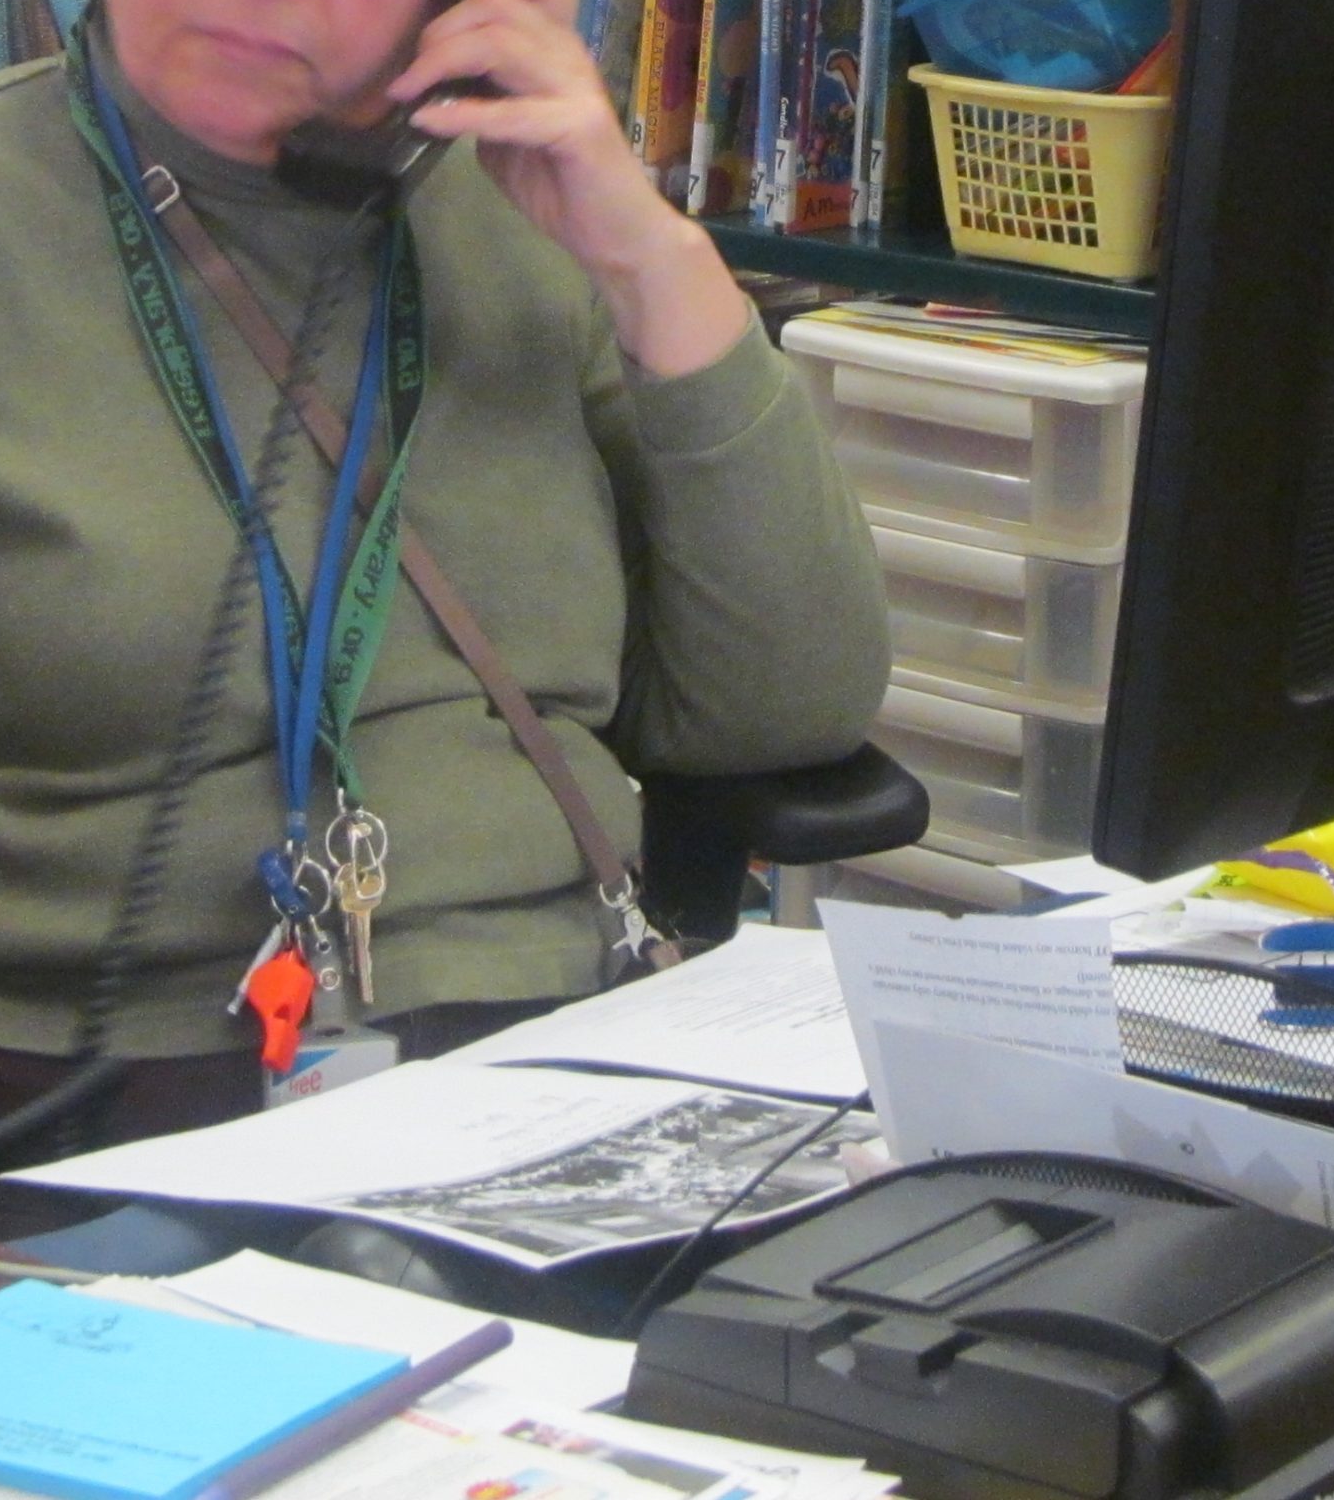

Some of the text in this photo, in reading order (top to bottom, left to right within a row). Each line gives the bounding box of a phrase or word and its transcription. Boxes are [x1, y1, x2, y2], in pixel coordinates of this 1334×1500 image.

[649, 86, 662, 147] MAGIC
[632, 124, 643, 144] 8
[776, 148, 787, 169] 7
[870, 148, 882, 170] 7
[689, 175, 700, 195] 7
